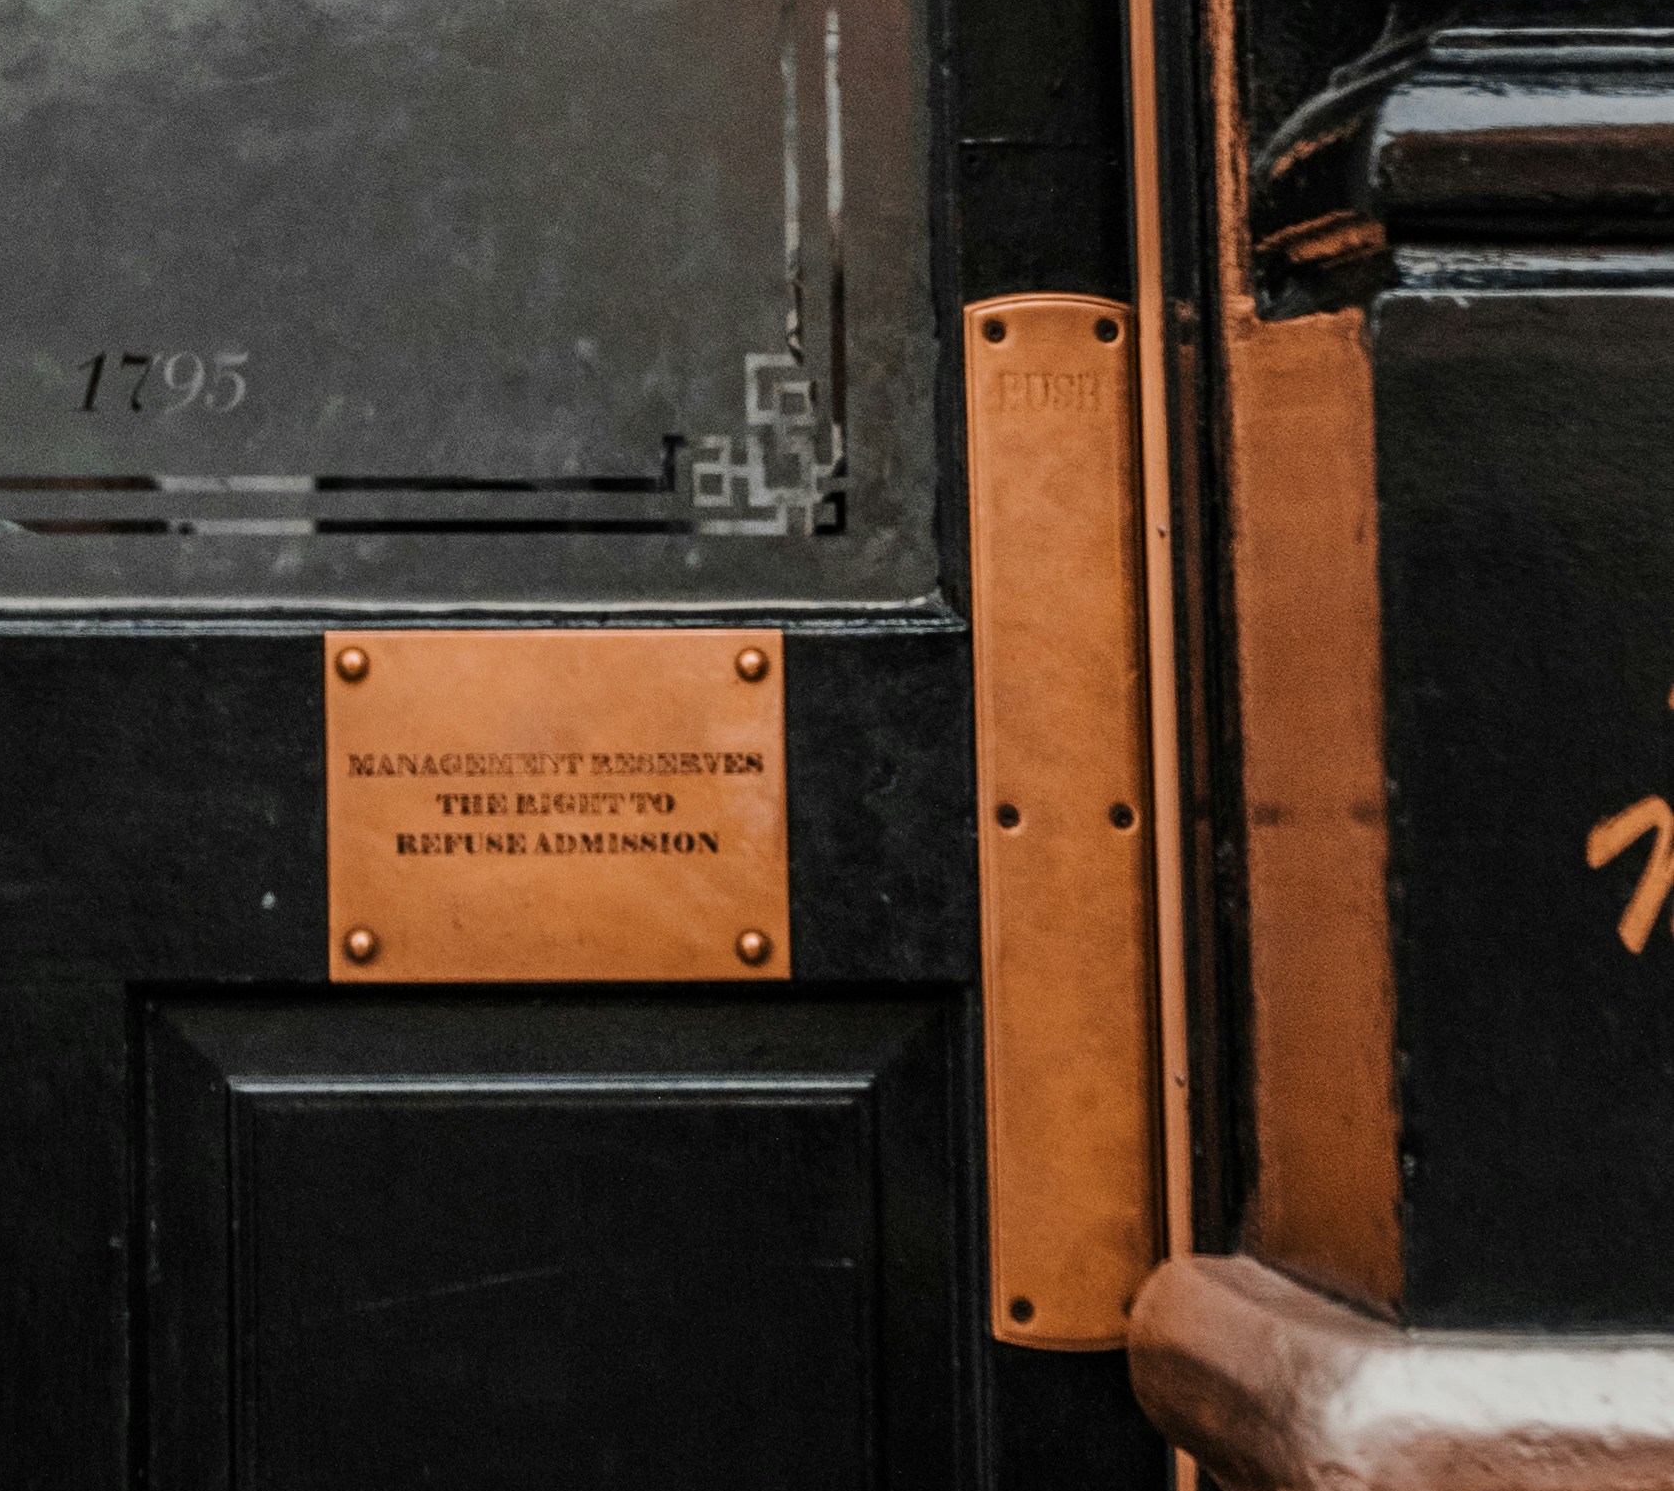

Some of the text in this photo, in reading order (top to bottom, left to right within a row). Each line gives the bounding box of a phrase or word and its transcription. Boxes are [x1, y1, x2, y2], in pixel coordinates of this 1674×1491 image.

[76, 350, 250, 414] 1795
[347, 751, 765, 778] MANAGEMENT RESERVES
[435, 791, 676, 817] THE RIGHT TO
[395, 831, 720, 856] REFUSE ADMISSION
